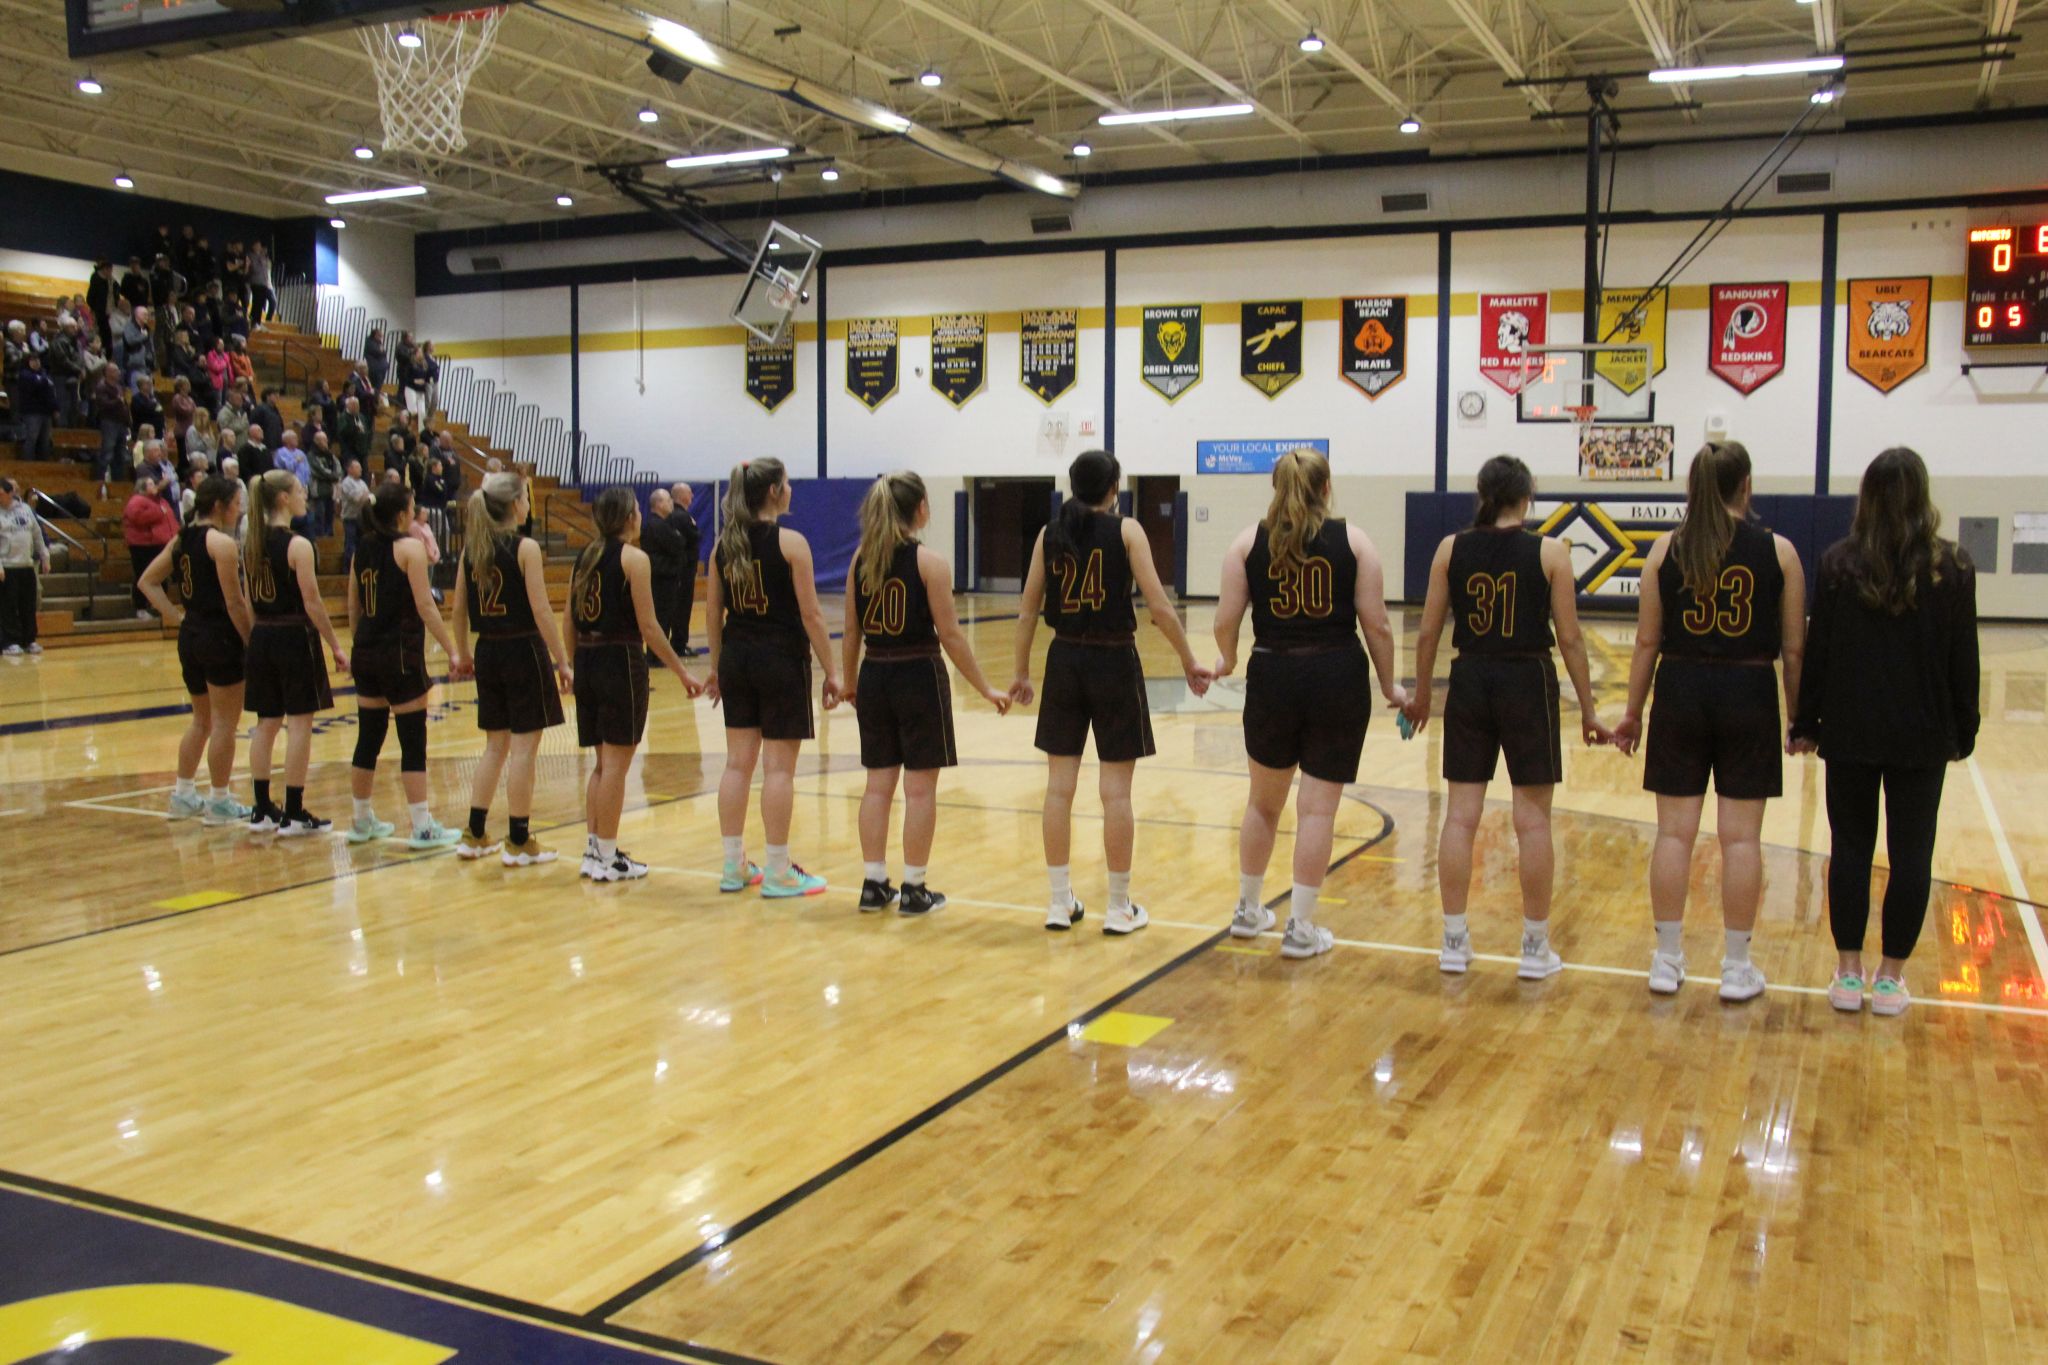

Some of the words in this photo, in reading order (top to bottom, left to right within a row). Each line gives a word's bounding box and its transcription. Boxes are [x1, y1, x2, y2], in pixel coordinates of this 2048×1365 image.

[1993, 244, 2011, 272] 0
[1718, 289, 1779, 301] SANDUSKY
[1876, 286, 1902, 295] UBLY
[1355, 299, 1393, 309] HARBOR
[1490, 297, 1538, 308] MARLETTE
[1145, 309, 1178, 319] BROWN
[1181, 308, 1199, 318] CITY
[1258, 306, 1287, 316] CAPAC
[1359, 308, 1389, 318] BEACH
[1979, 306, 1992, 328] 0
[1972, 333, 1993, 343] won
[1721, 351, 1773, 362] REDSKINS
[1859, 350, 1914, 359] BEARCATS
[1355, 359, 1391, 370] PIRATES
[1481, 357, 1499, 366] RED
[1503, 356, 1543, 366] RAIERS
[1144, 365, 1170, 374] GREEN
[1173, 364, 1199, 374] DEVILS
[1258, 362, 1286, 372] CHIEFS
[1213, 443, 1240, 454] YOUR
[1242, 443, 1271, 453] LOCAL
[1632, 506, 1667, 518] BAD
[181, 554, 192, 599] 3
[1052, 549, 1105, 614] 24
[471, 566, 507, 617] 12
[724, 559, 768, 615] 14
[1268, 555, 1333, 619] 30
[862, 577, 906, 636] 20
[1467, 571, 1516, 638] 31
[1683, 565, 1754, 638] 33
